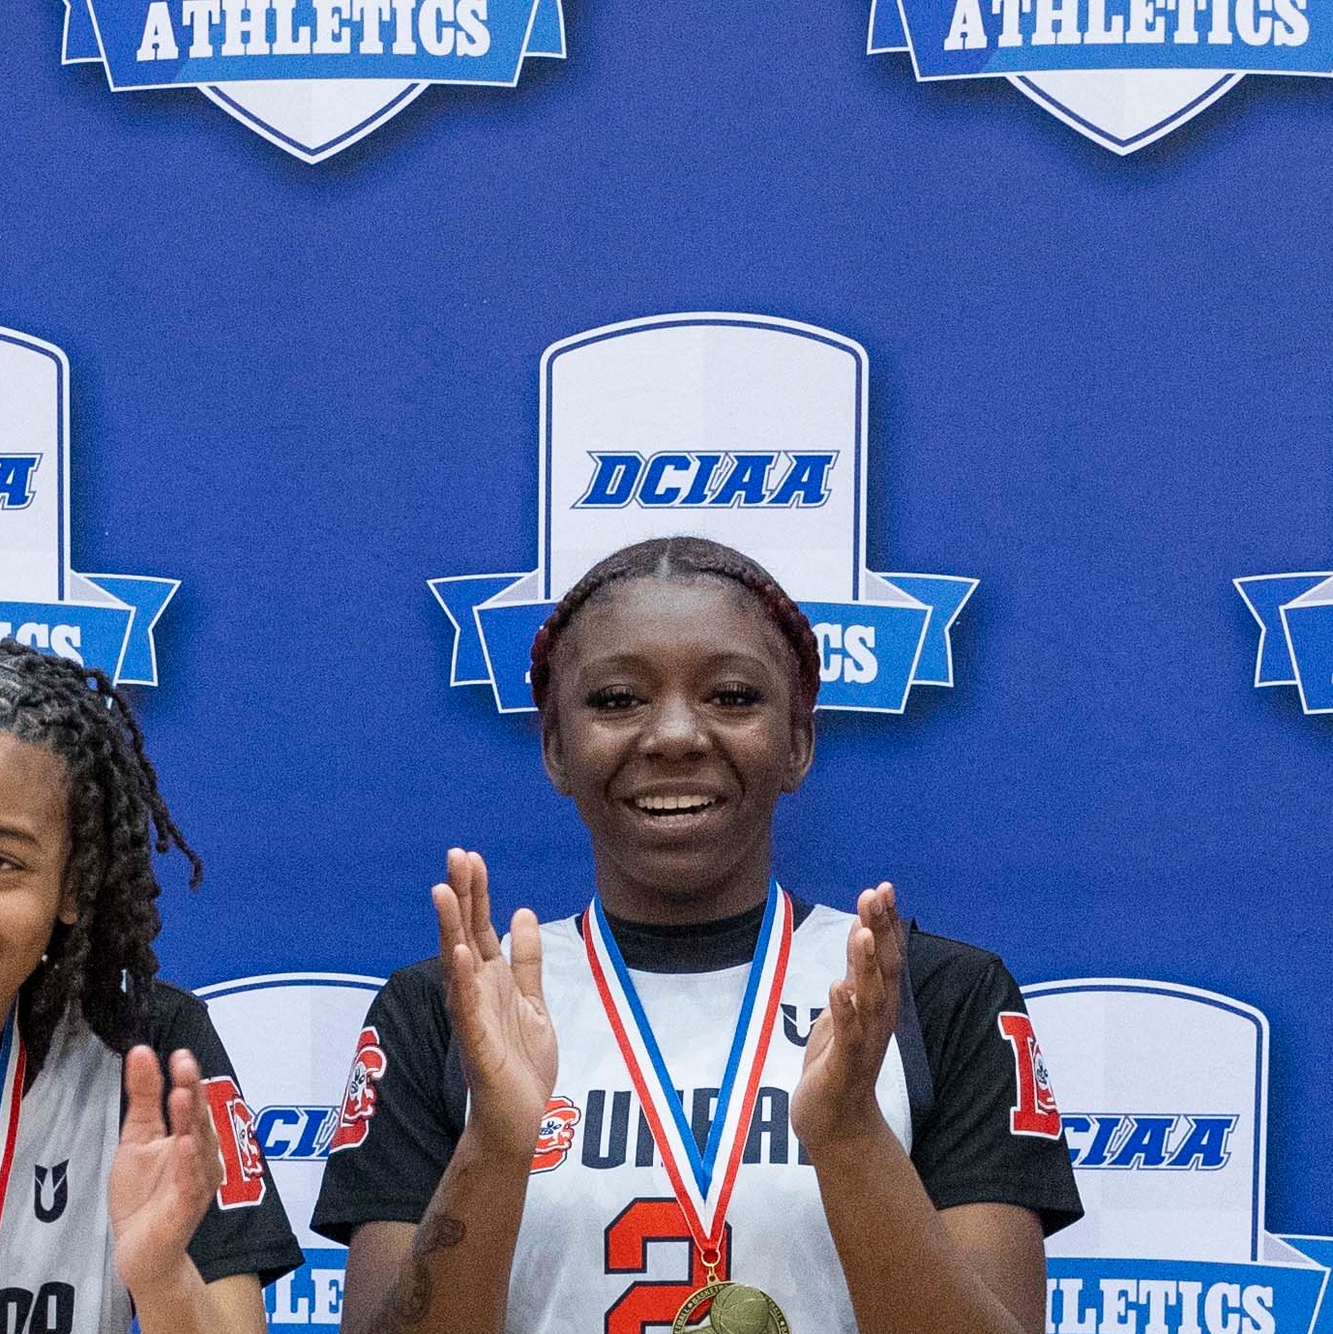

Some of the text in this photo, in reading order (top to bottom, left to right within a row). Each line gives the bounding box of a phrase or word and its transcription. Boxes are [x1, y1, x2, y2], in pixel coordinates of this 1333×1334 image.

[136, 0, 491, 61] ATHLETICS
[944, 0, 1310, 51] ATHLETICS
[571, 450, 839, 509] DCIAA
[1060, 1114, 1240, 1171] CIAA
